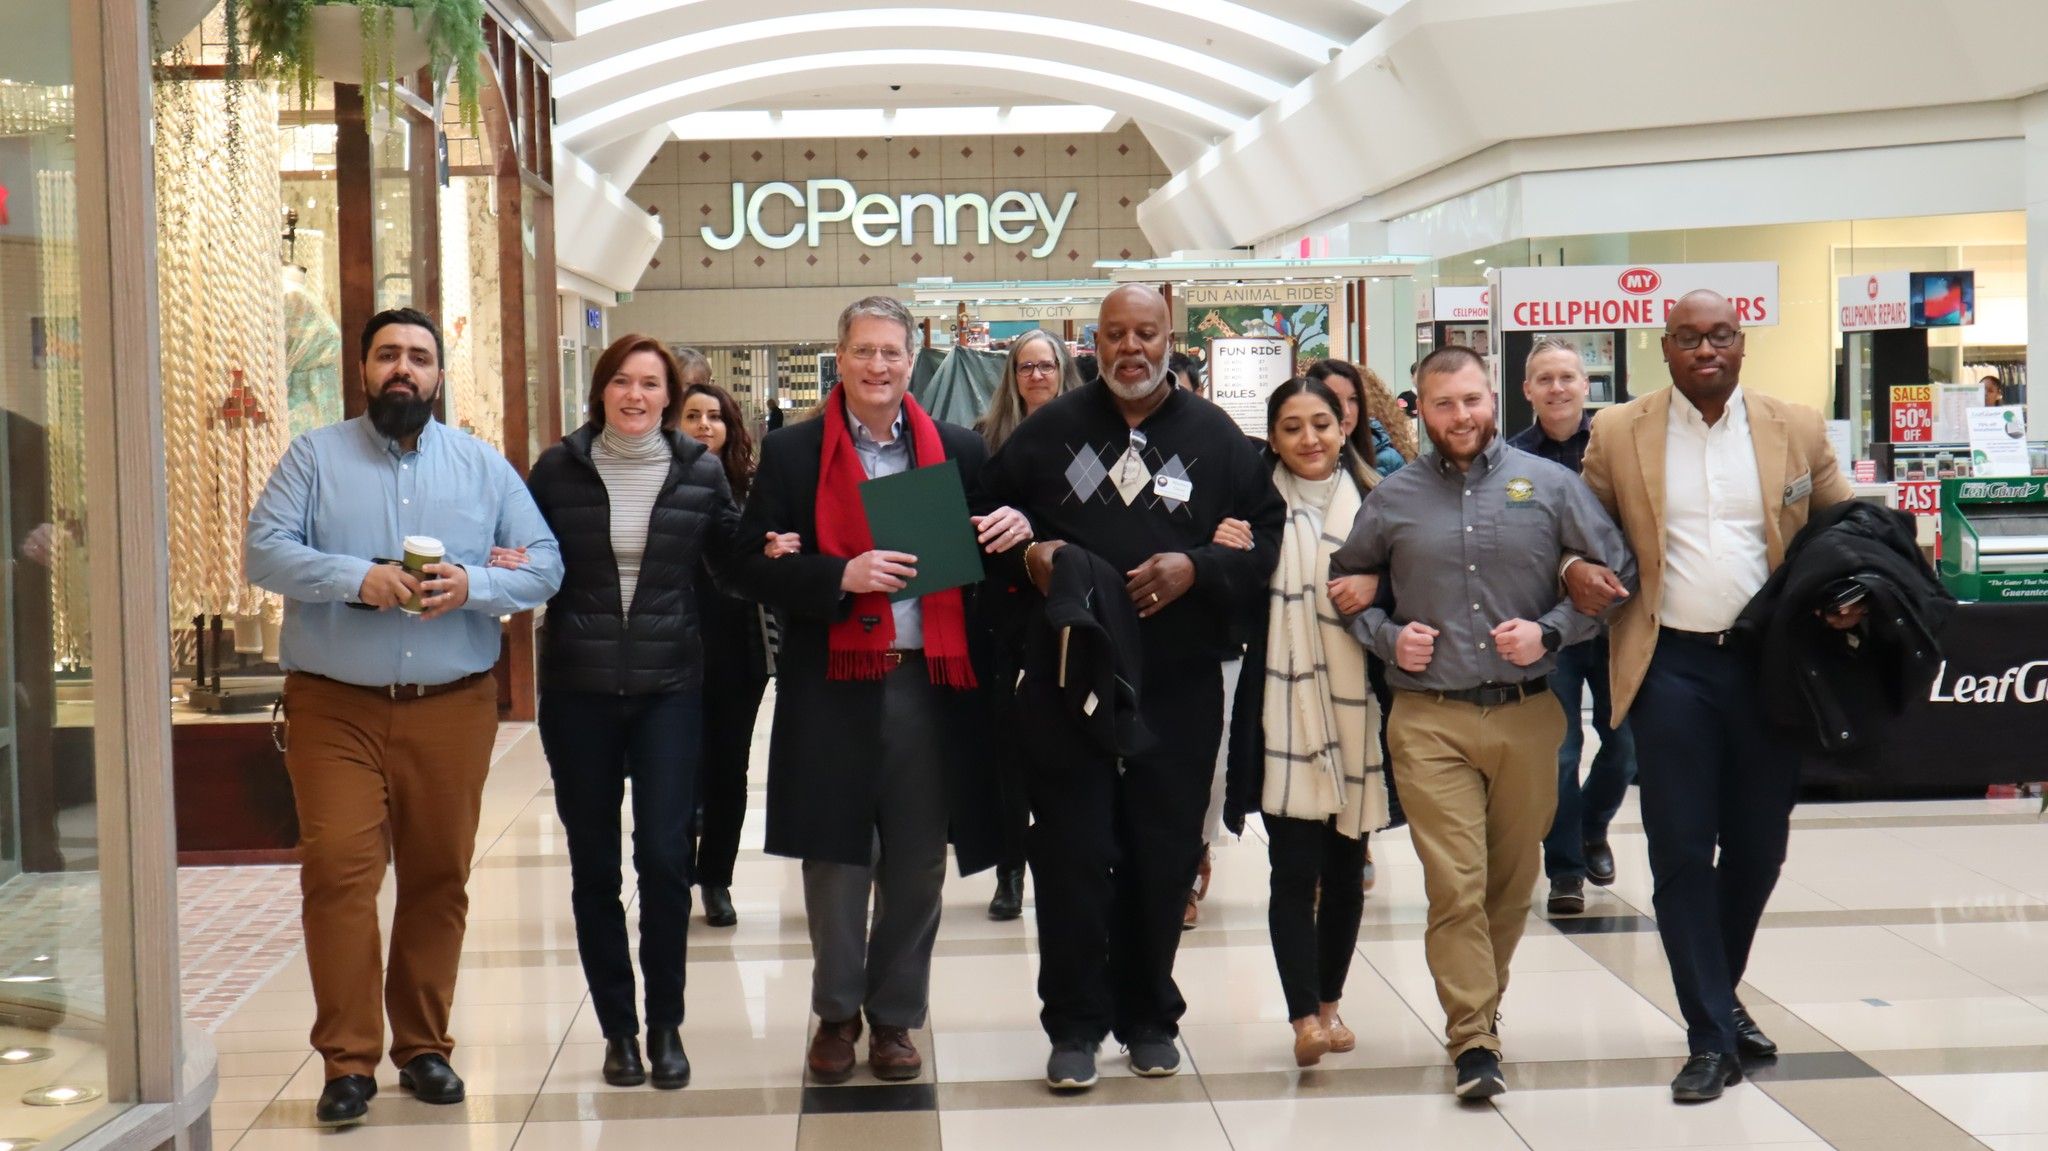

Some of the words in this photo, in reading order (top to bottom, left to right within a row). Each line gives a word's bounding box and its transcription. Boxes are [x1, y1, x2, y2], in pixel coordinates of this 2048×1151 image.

[700, 178, 1078, 259] JCPenney
[1626, 275, 1652, 288] MY
[1187, 289, 1218, 302] FUN
[1223, 288, 1281, 302] ANIMAL
[1287, 287, 1334, 300] RIDES
[1019, 306, 1043, 318] TOY
[1046, 306, 1074, 318] CITY
[1453, 307, 1488, 317] CELLPHON
[1513, 299, 1653, 326] CELLPHONE
[1841, 304, 1877, 327] CELLPHONE
[1879, 302, 1907, 324] REPAIRS
[1219, 347, 1246, 356] FUN
[1251, 345, 1282, 355] RIDE
[1216, 390, 1257, 398] RULES
[1893, 387, 1931, 401] SALES
[1895, 408, 1932, 428] 50%
[1903, 429, 1922, 441] OFF
[1895, 485, 1941, 510] FAST
[1959, 482, 2030, 498] LeafGuard
[1929, 659, 2048, 704] LeafG
